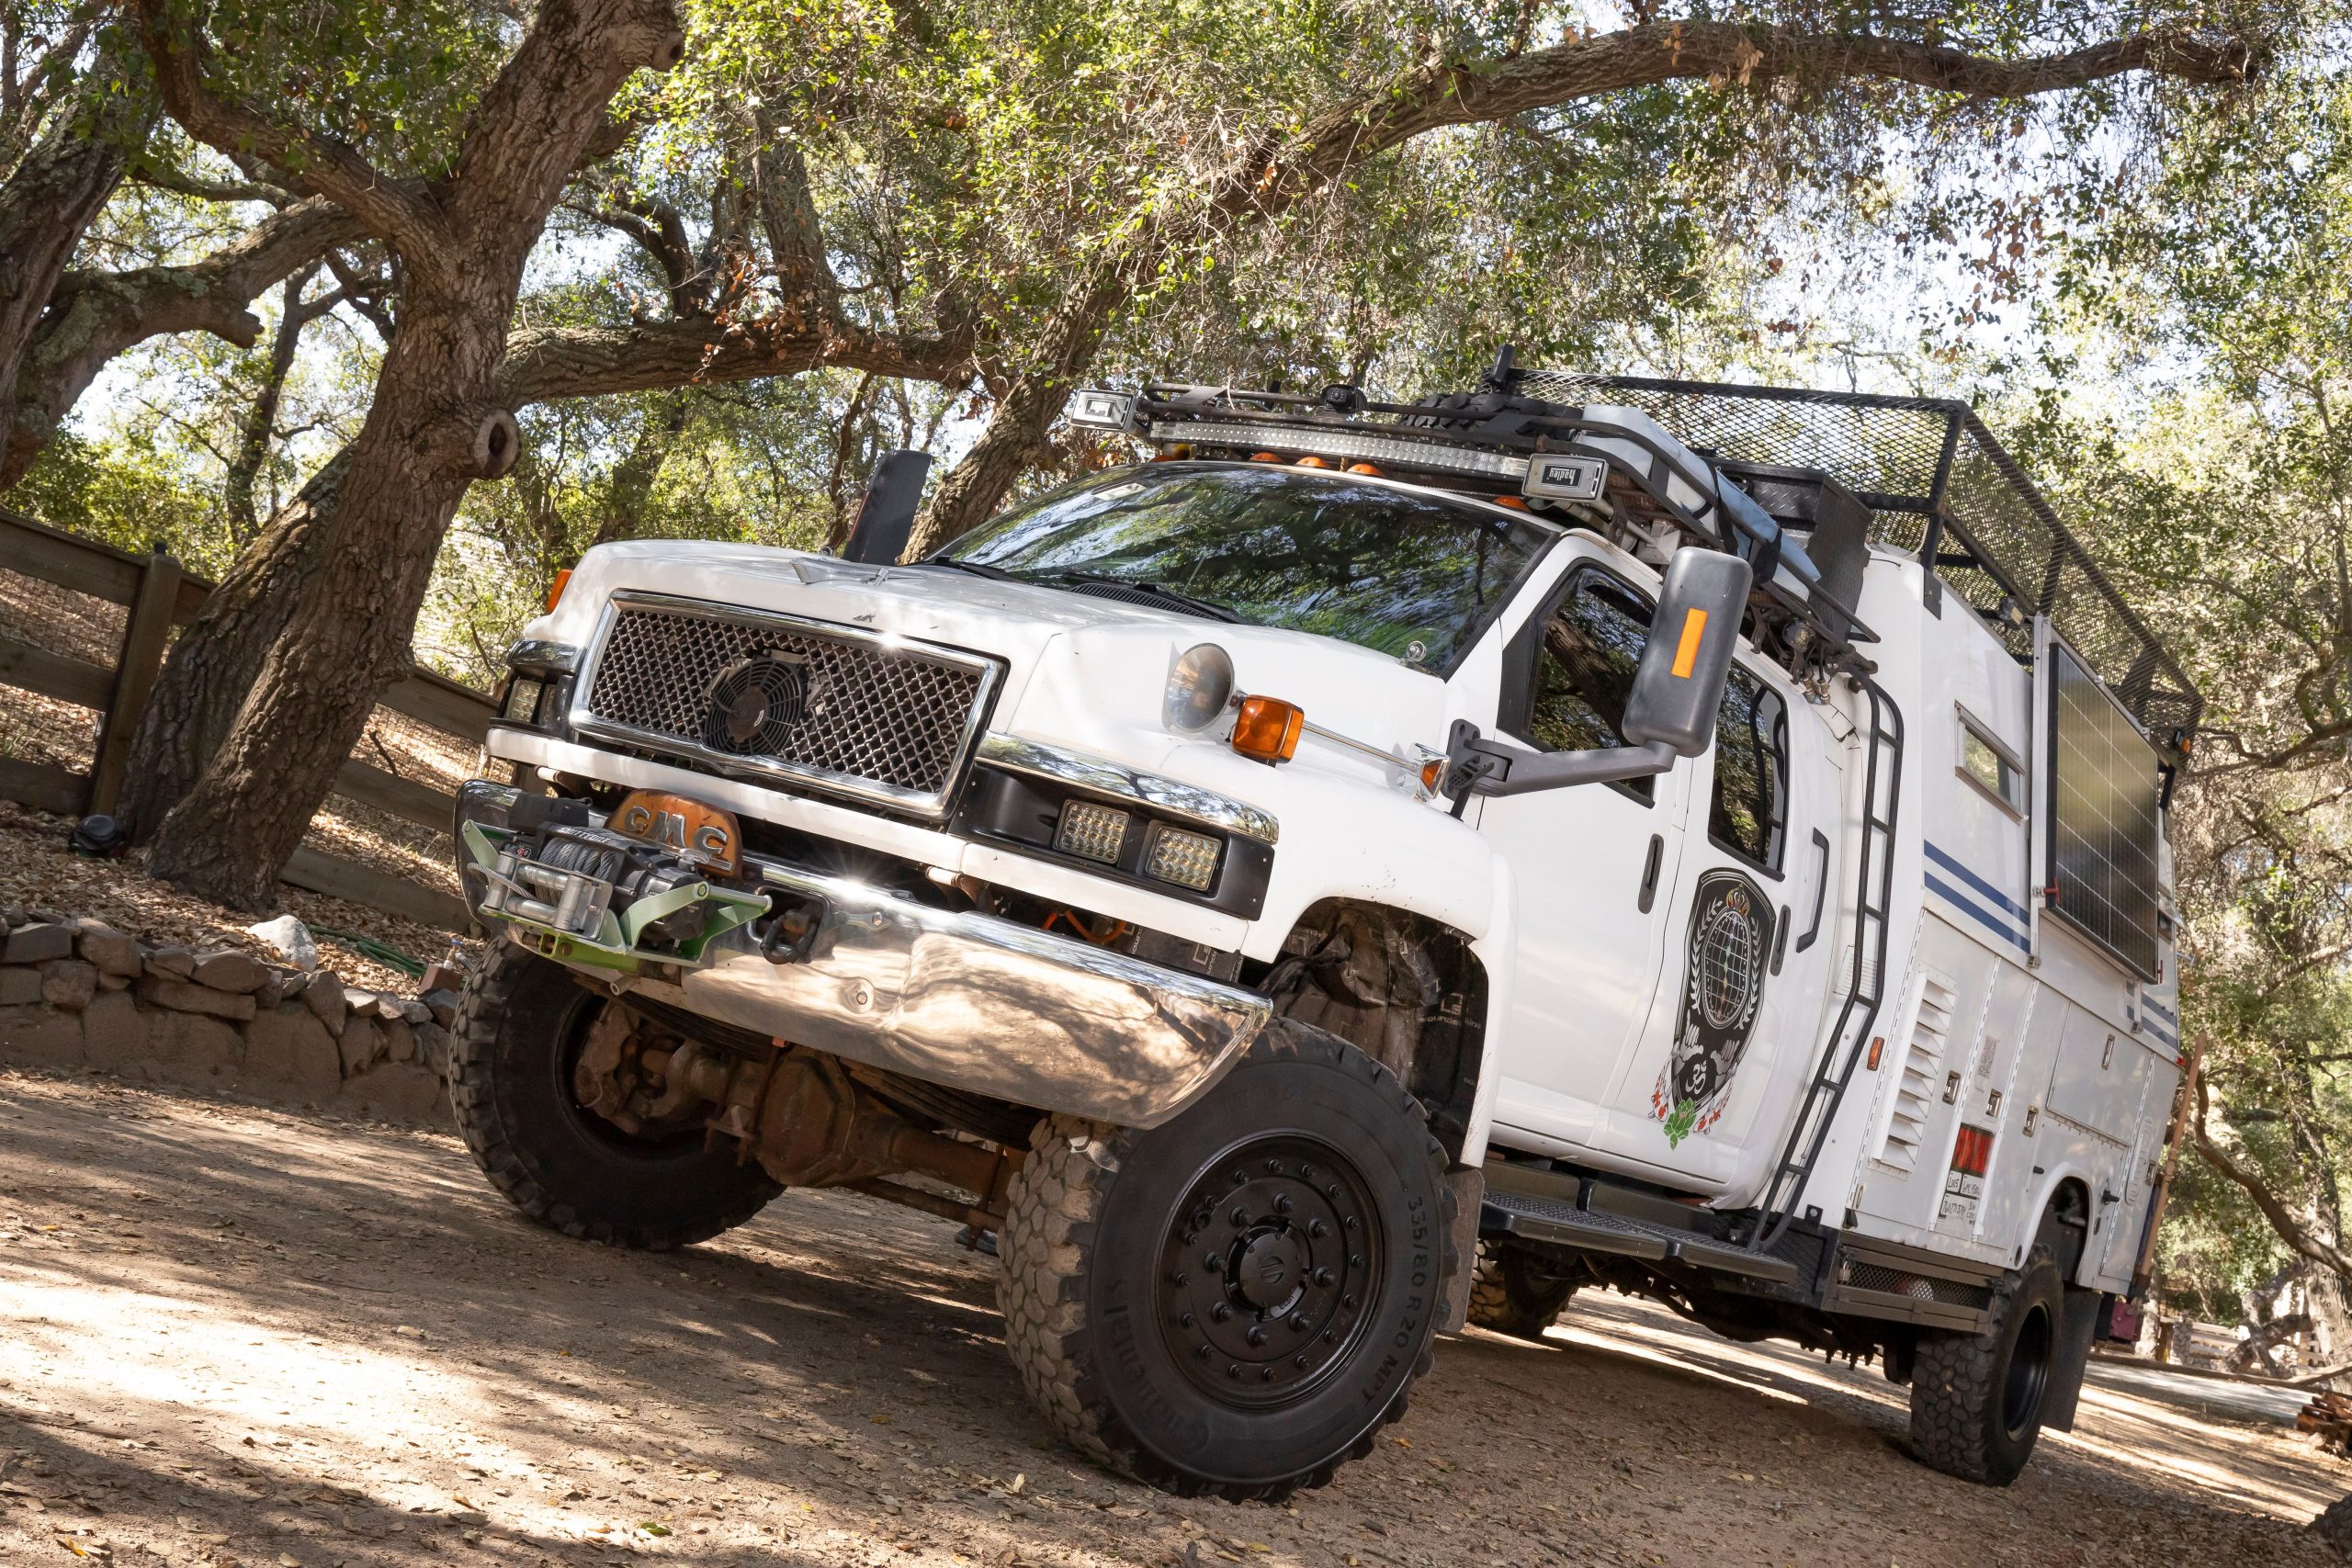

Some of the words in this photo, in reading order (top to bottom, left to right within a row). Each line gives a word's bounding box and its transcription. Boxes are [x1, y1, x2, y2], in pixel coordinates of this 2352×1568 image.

[1548, 467, 1577, 485] hadley
[624, 806, 728, 855] GMC
[1408, 1196, 1430, 1287] 335/80
[1361, 1353, 1398, 1406] MPT
